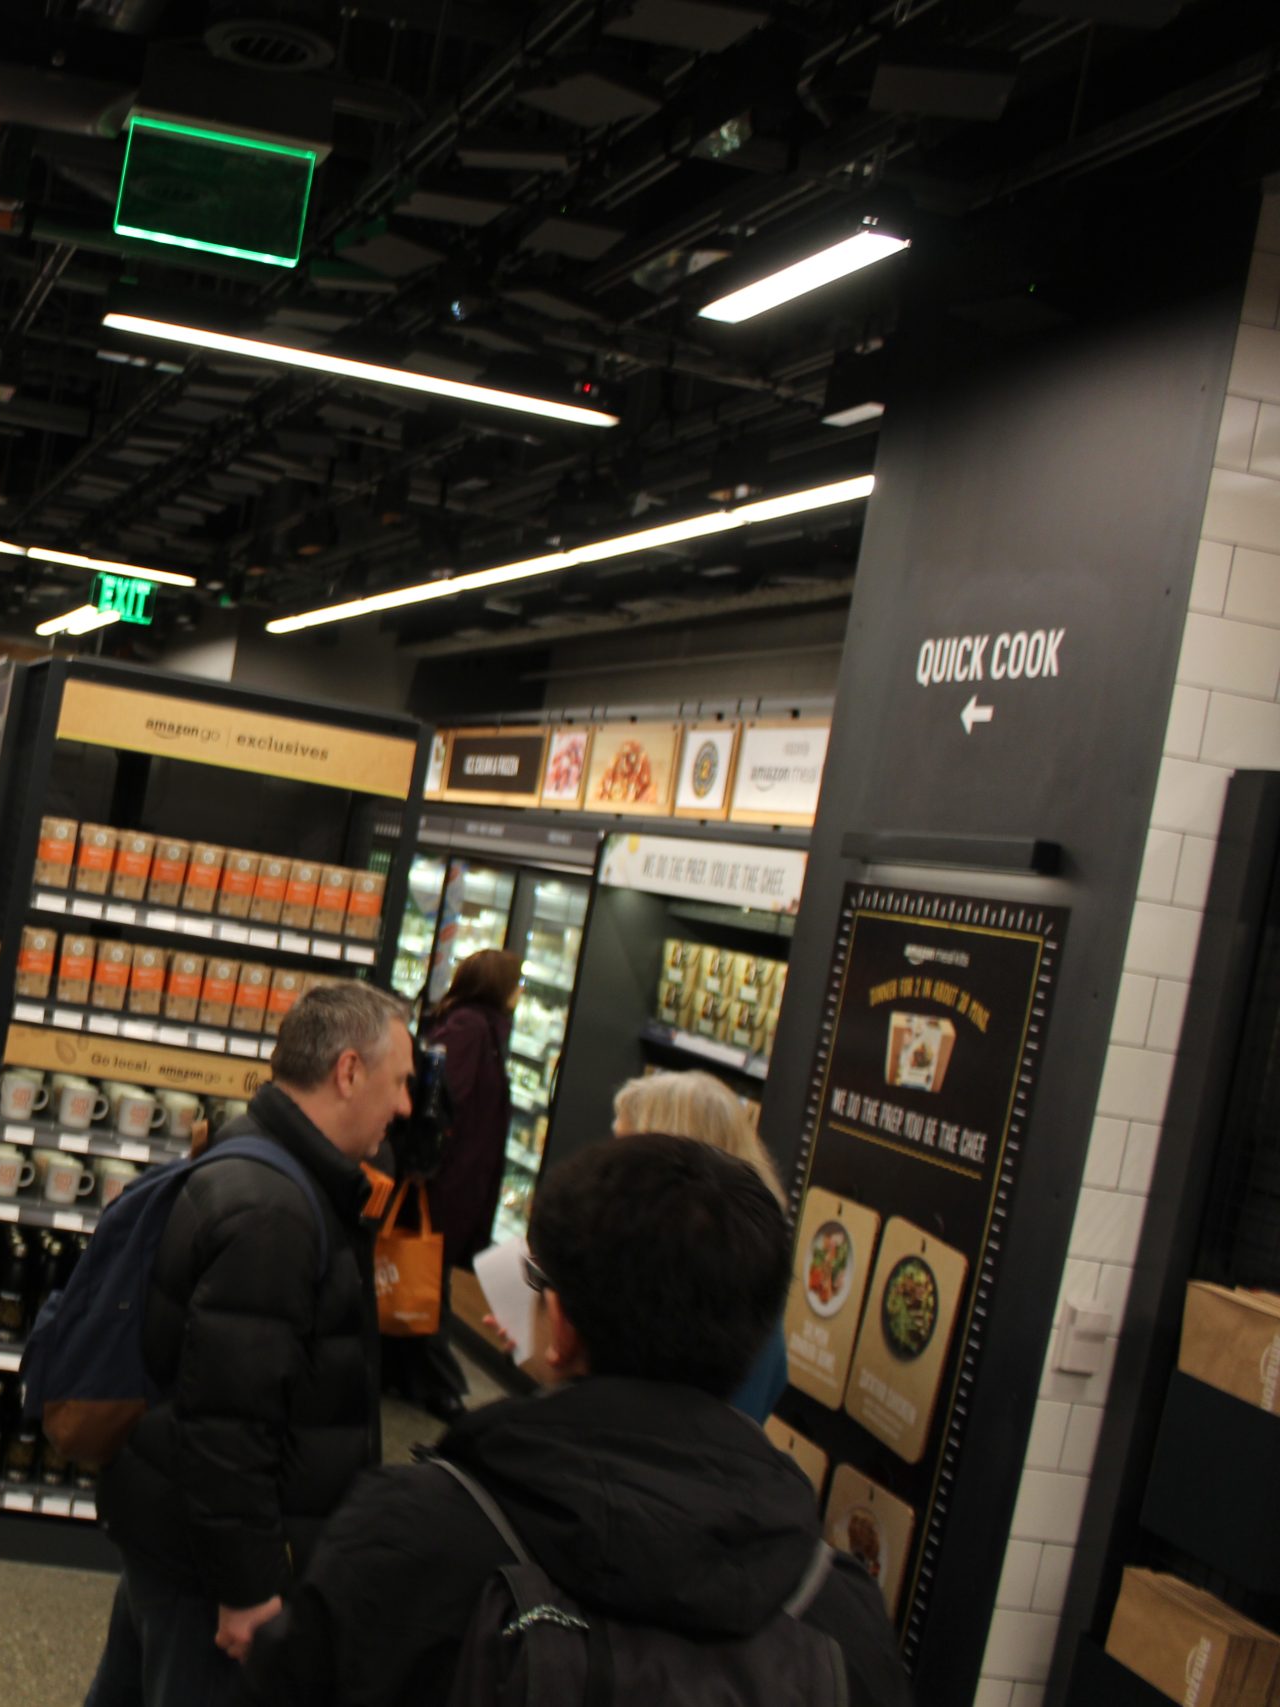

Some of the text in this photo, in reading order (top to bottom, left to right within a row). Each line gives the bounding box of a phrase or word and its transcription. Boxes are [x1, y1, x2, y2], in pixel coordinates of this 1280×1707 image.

[98, 575, 152, 618] EXIT
[916, 627, 1066, 688] QUICK COOK
[145, 717, 200, 740] amazon
[236, 732, 329, 761] exclusives
[158, 1063, 204, 1083] amazon
[831, 1087, 847, 1116] WE
[846, 1090, 862, 1120] DO
[860, 1096, 880, 1127] THE
[903, 1110, 925, 1141] YOU
[923, 1116, 939, 1147] BE
[938, 1121, 960, 1154] THE
